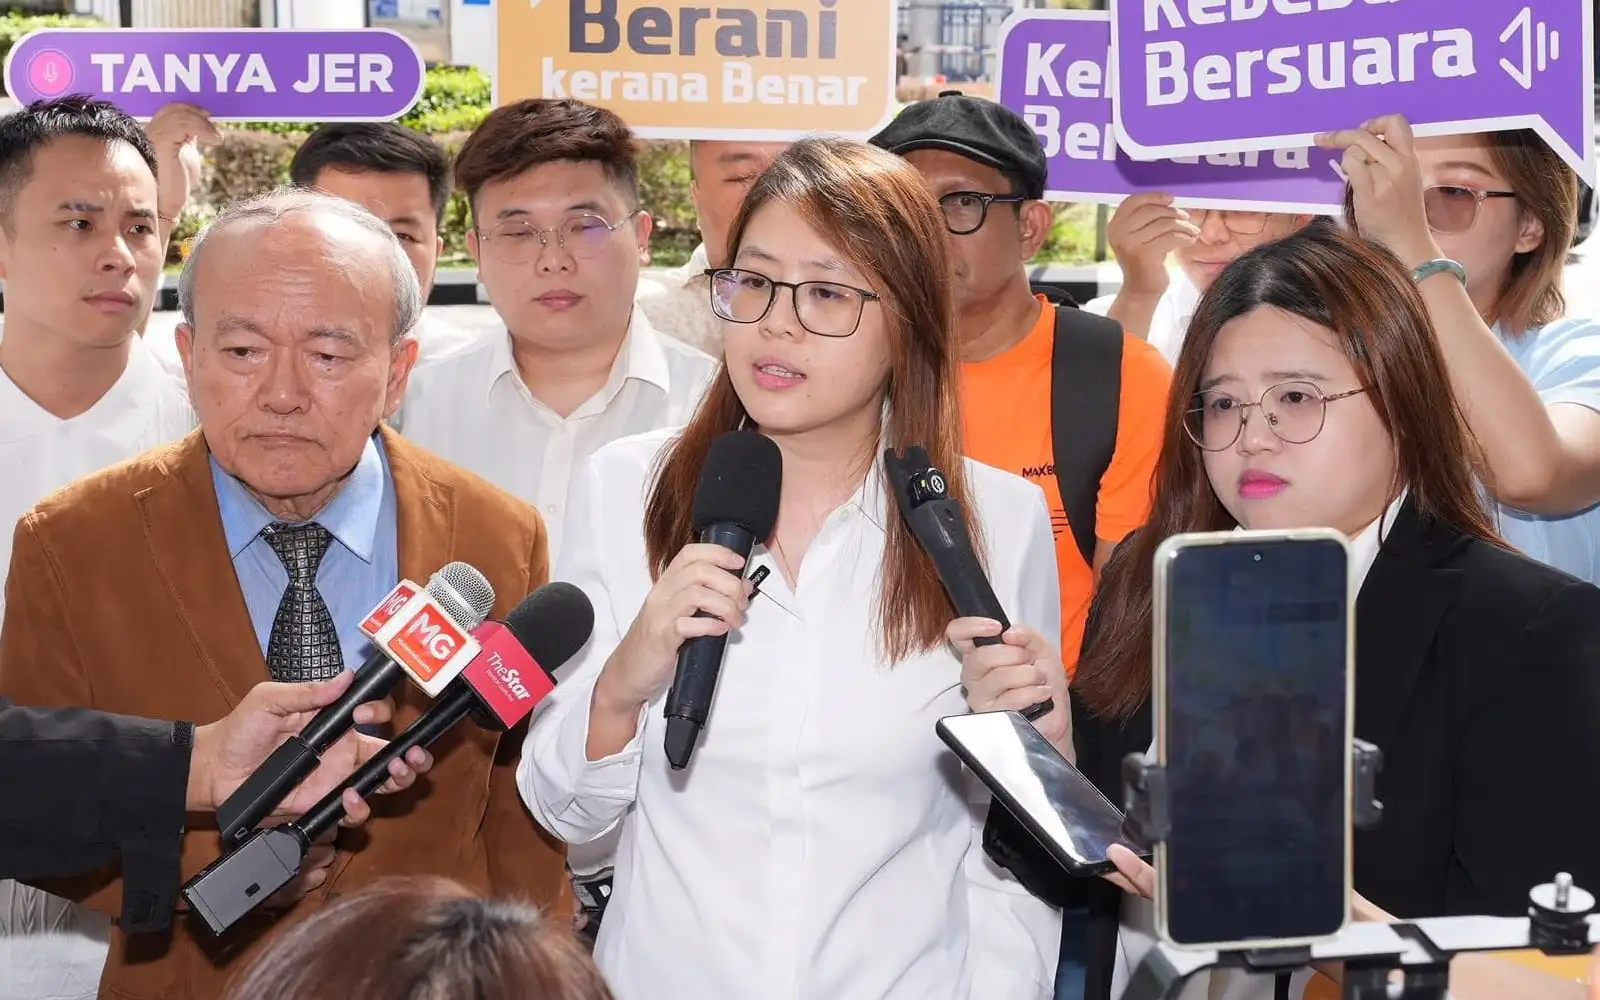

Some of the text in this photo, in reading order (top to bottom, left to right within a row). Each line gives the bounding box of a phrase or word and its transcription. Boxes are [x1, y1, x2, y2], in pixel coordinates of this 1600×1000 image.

[569, 0, 837, 59] Berani
[91, 53, 394, 93] TANYA JER
[541, 57, 868, 106] kerana Benar
[1024, 42, 1112, 98] Ke
[1145, 28, 1477, 106] Bersuara
[406, 612, 456, 660] MG
